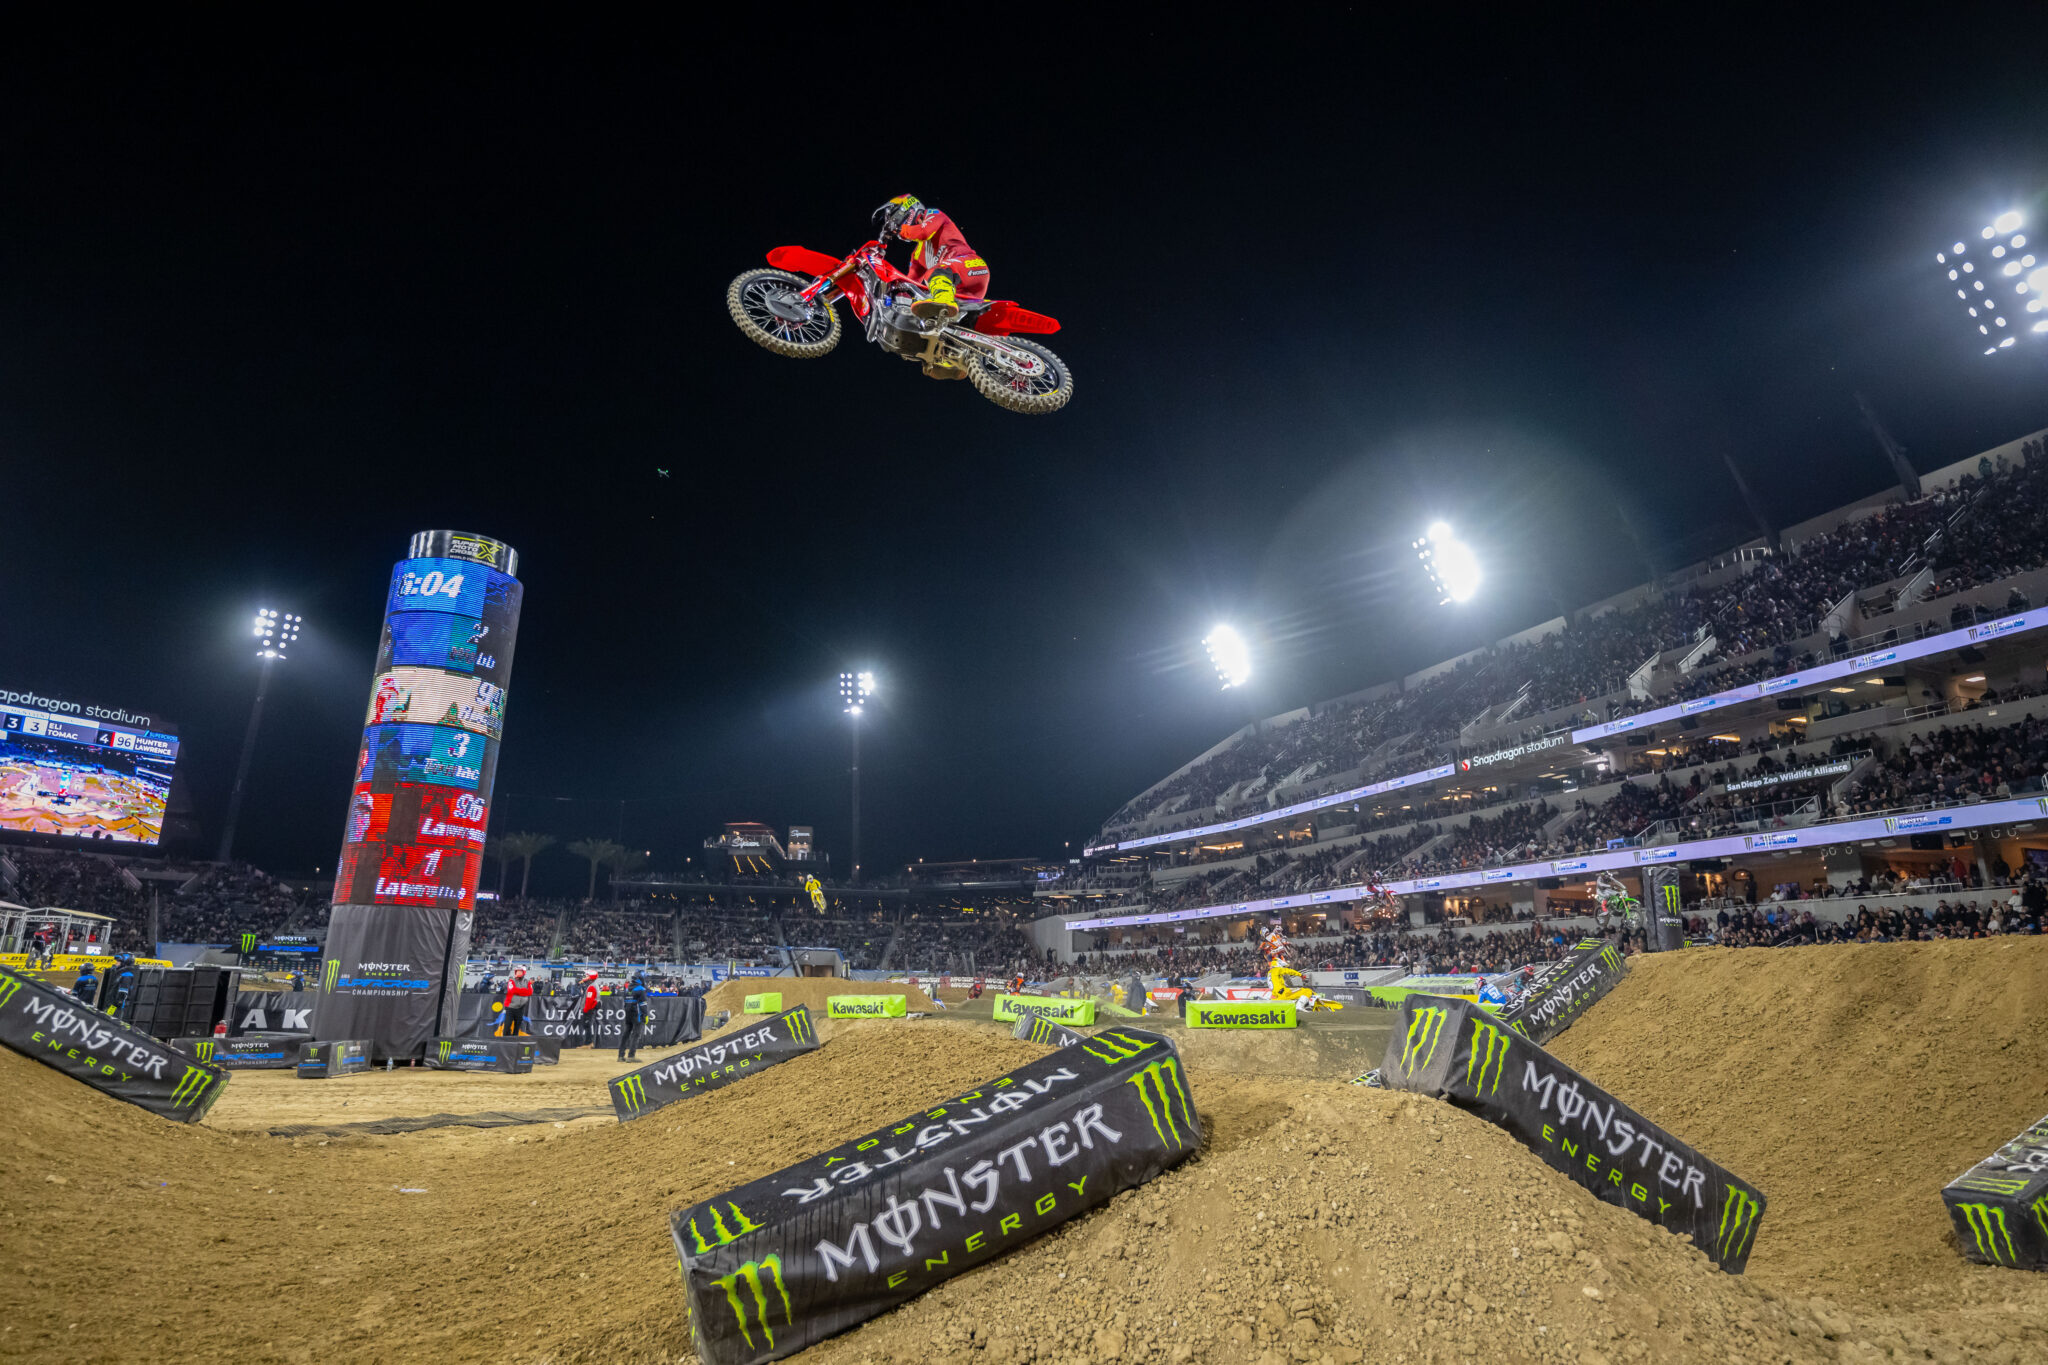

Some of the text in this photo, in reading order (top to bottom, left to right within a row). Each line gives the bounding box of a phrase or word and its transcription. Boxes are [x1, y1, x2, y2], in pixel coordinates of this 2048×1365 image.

[7, 717, 62, 733] 3 3 ELI
[86, 705, 150, 727] stadium
[48, 729, 168, 749] TOMAC 4 96 HUNTER
[135, 744, 172, 756] LAWRENCE
[448, 732, 470, 758] 3
[1473, 736, 1564, 767] Snapdragon stadium
[1726, 763, 1848, 791] San Diego Zoo Wildlife Alliance
[454, 793, 485, 822] 96
[424, 849, 443, 876] 1
[358, 962, 410, 971] MONSTER
[337, 978, 430, 988] SUPERCROSS
[1530, 963, 1601, 1025] MONSTER
[596, 1009, 656, 1020] SPOS
[833, 1001, 884, 1015] Kawasaki
[1002, 1000, 1074, 1019] Kawasaki
[1200, 1010, 1286, 1025] Kawasaki
[1550, 986, 1596, 1027] ENERGY
[23, 996, 168, 1080] MONSTER
[544, 1025, 655, 1036] COMISSN
[32, 1031, 132, 1082] ENERGY
[654, 1026, 777, 1085] MONSTER
[680, 1053, 763, 1092] ENERGY
[781, 1068, 1079, 1203] MONSTER
[824, 1078, 1013, 1168] ENERGY
[1523, 1061, 1707, 1208] MONSTER
[1543, 1123, 1671, 1214] ENERGY
[816, 1103, 1122, 1282] MONSTER
[887, 1175, 1088, 1289] ENERGY
